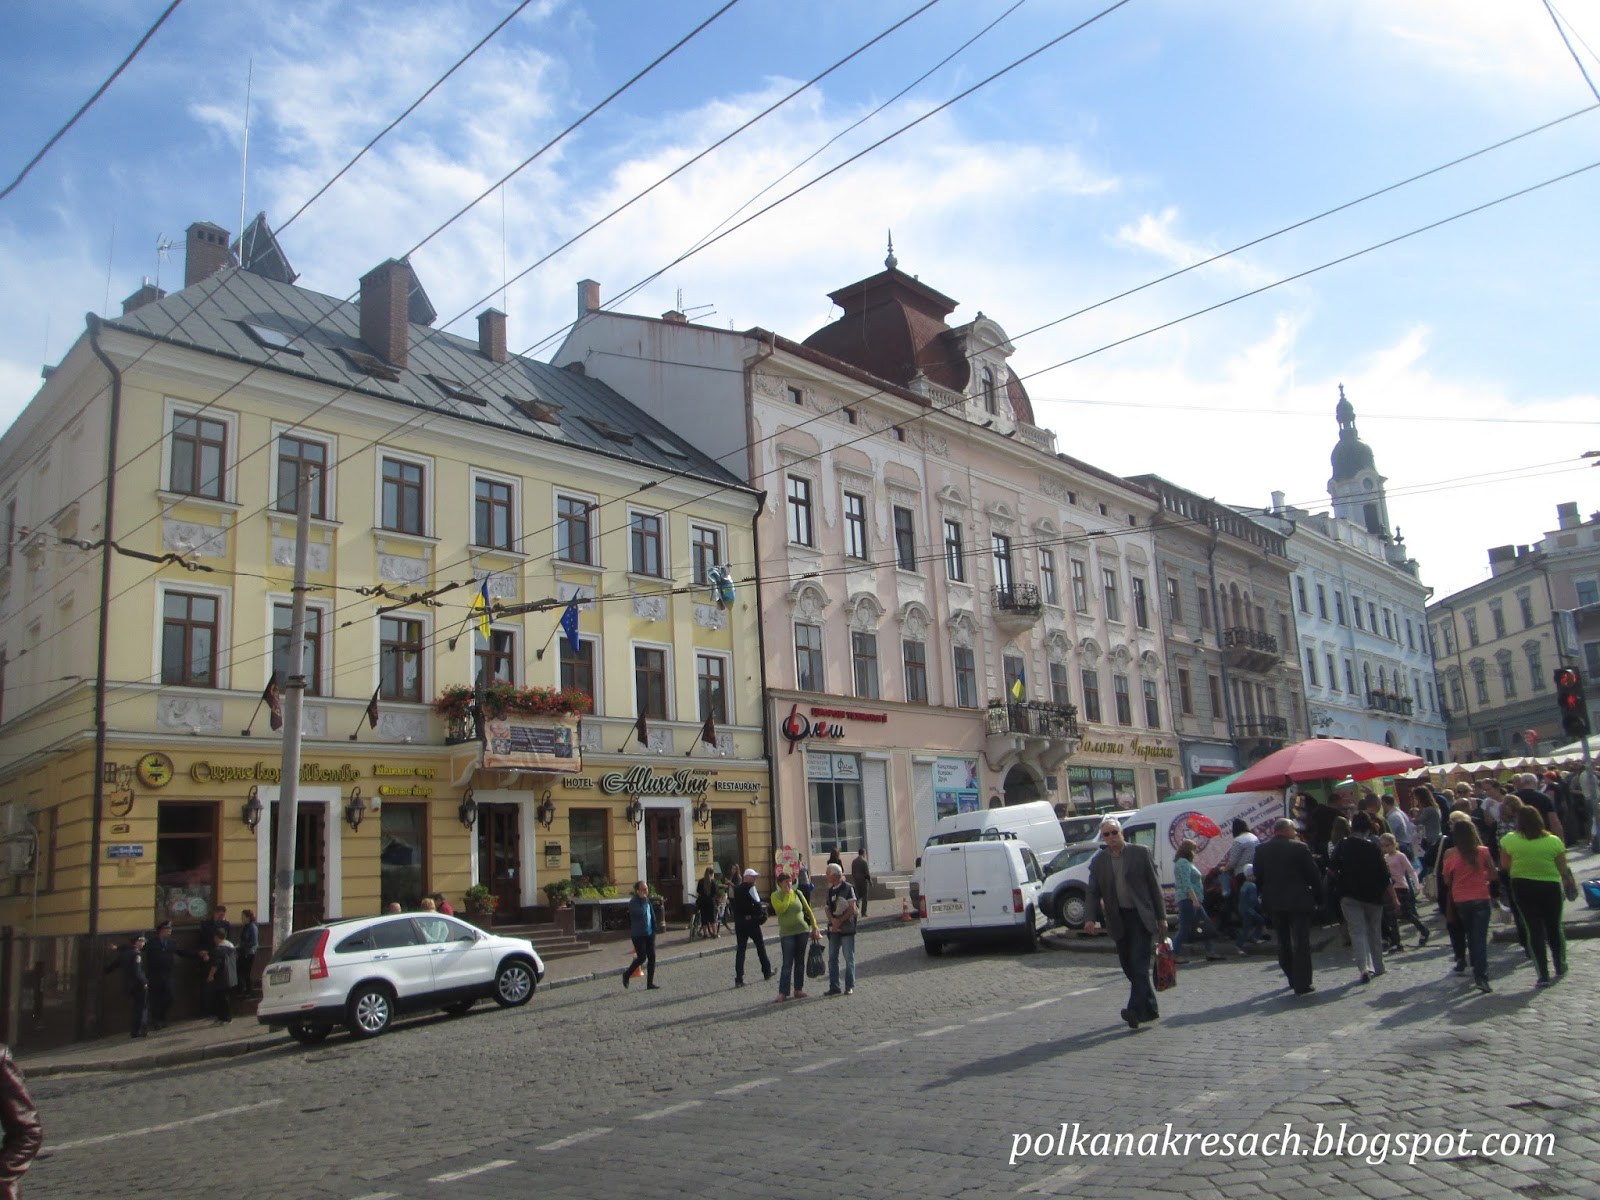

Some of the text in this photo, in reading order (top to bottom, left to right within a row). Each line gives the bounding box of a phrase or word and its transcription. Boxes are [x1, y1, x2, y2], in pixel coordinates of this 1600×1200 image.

[374, 764, 414, 777] Магазин
[565, 777, 594, 789] HOTEL
[603, 765, 711, 794] Allure Inn
[379, 784, 411, 797] Cheese
[716, 781, 761, 792] RESTAURANT
